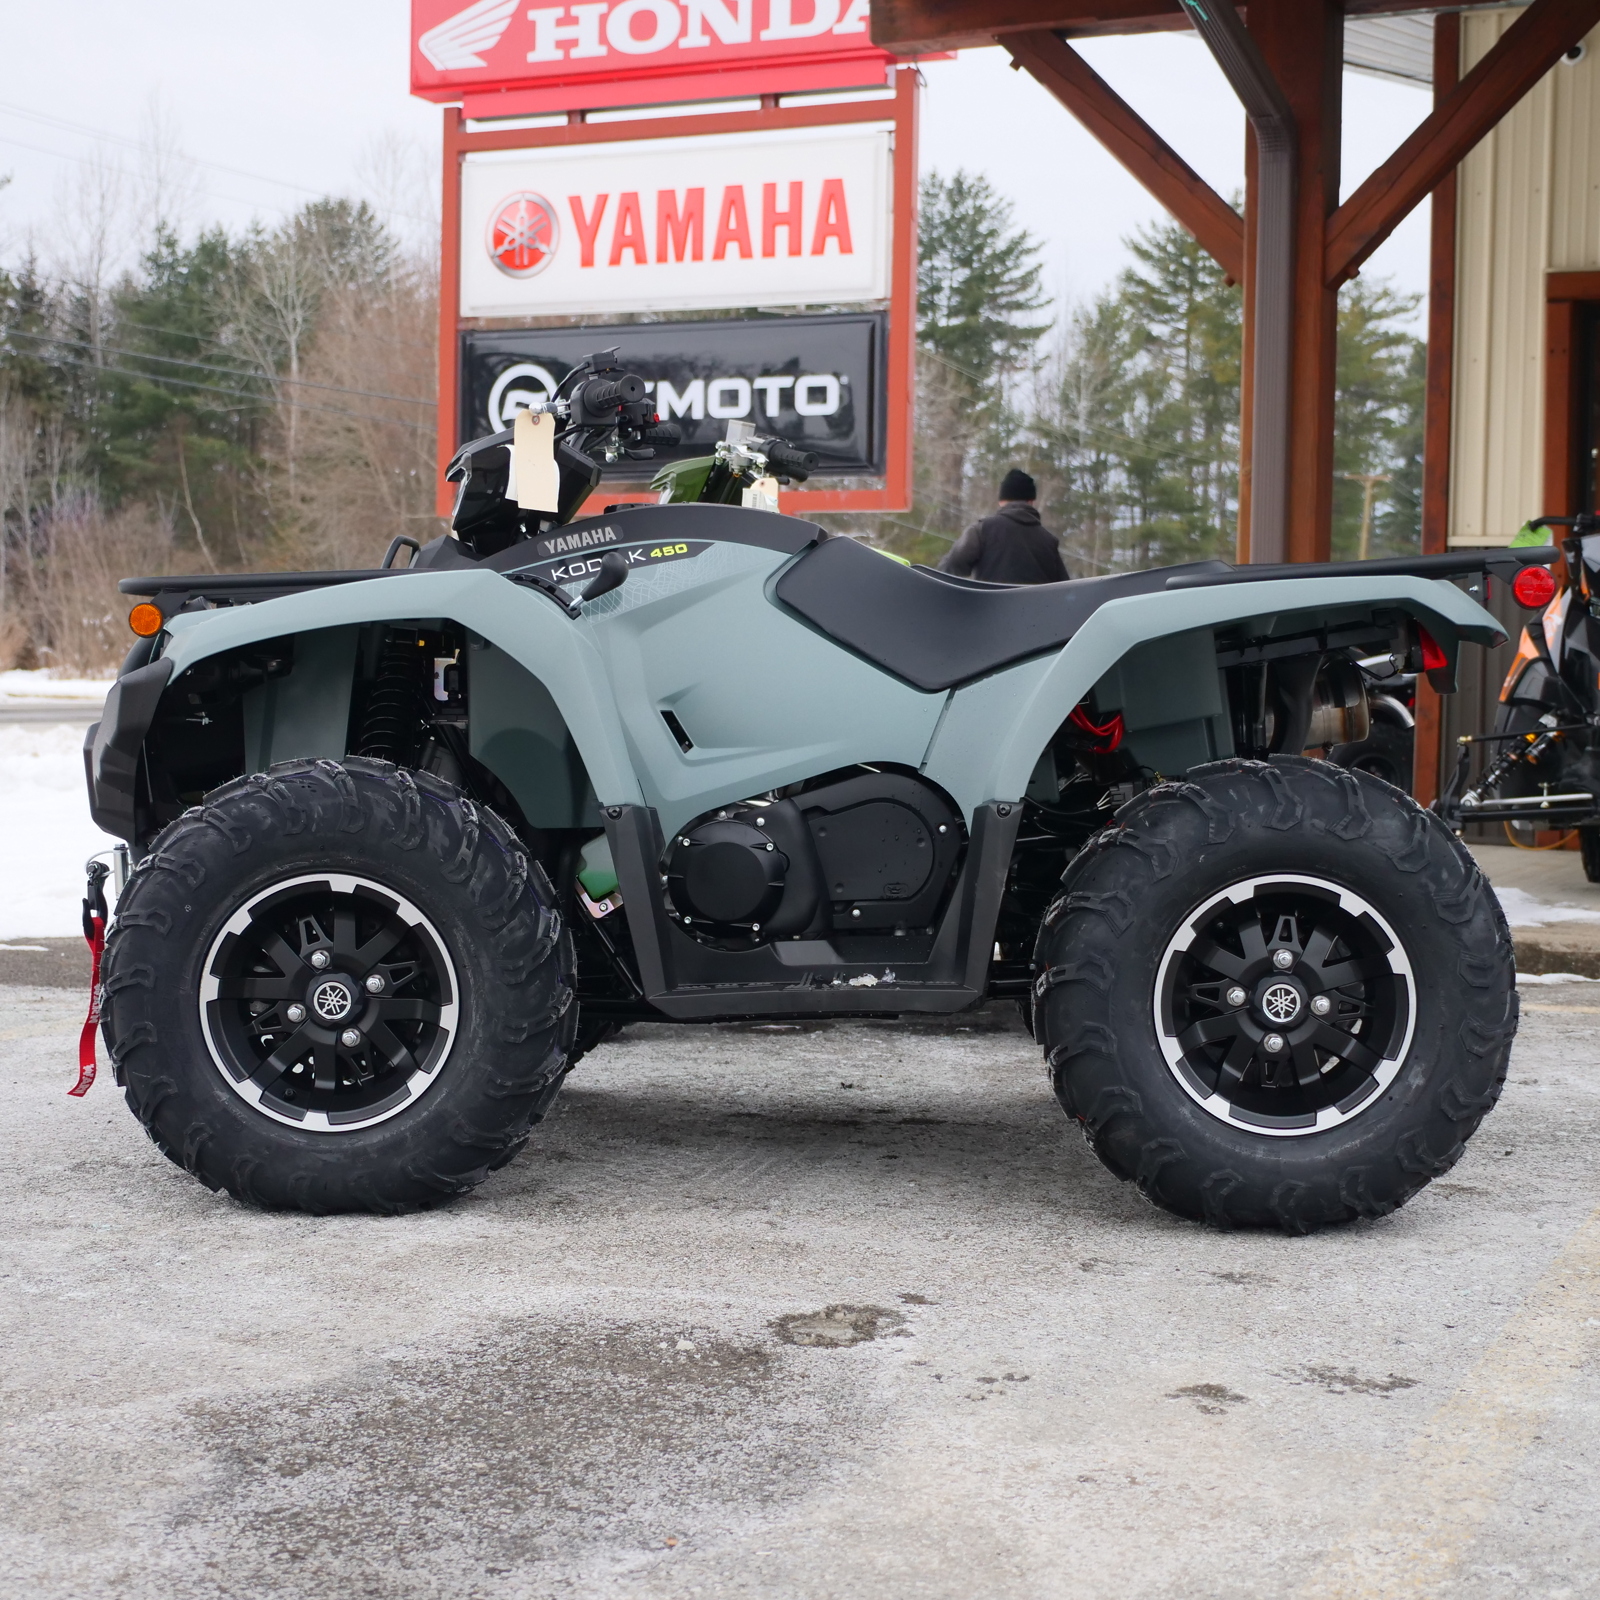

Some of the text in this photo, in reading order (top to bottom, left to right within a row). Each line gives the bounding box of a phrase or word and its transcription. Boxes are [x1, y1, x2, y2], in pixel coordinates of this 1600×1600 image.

[567, 178, 854, 268] YAMAHA
[645, 374, 840, 421] MOTO
[544, 526, 617, 554] YAMAHA
[551, 543, 688, 581] KODK 450
